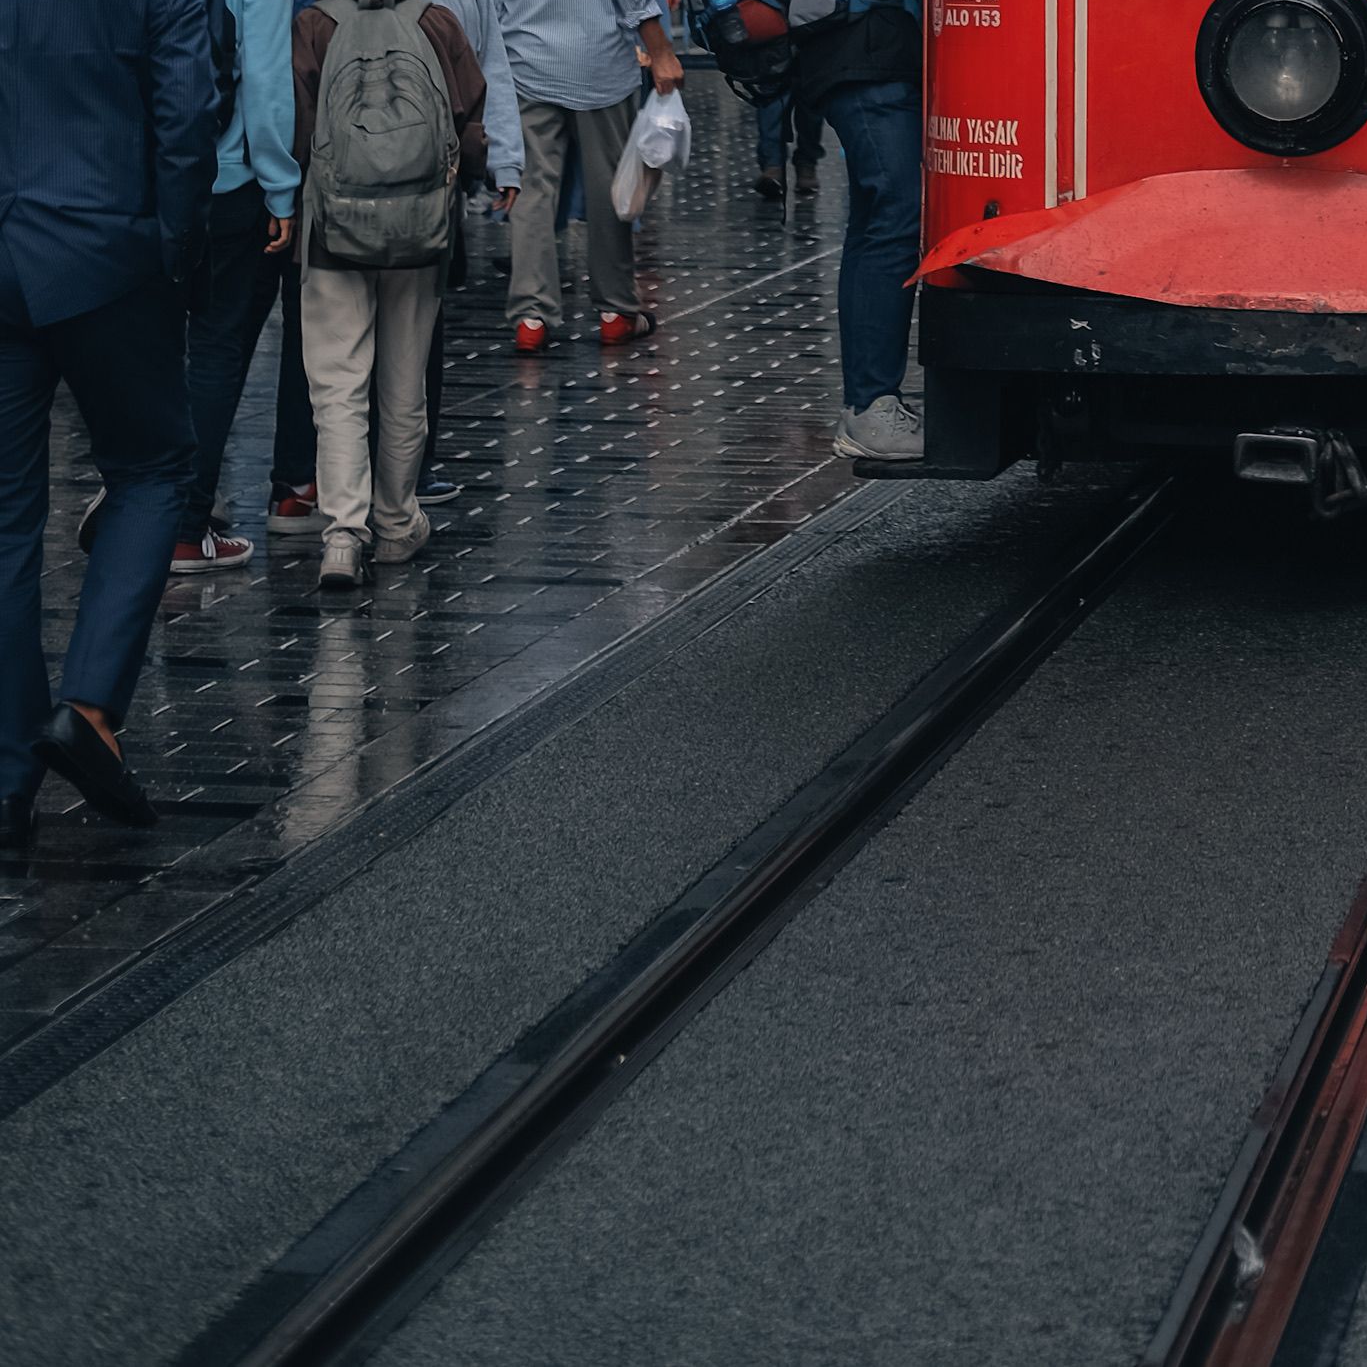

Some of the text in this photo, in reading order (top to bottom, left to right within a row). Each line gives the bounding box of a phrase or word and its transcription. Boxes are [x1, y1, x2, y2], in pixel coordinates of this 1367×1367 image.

[945, 9, 1001, 28] ALO 153
[966, 118, 1019, 146] YASAK
[933, 147, 1024, 179] TEHLİKELİDİR
